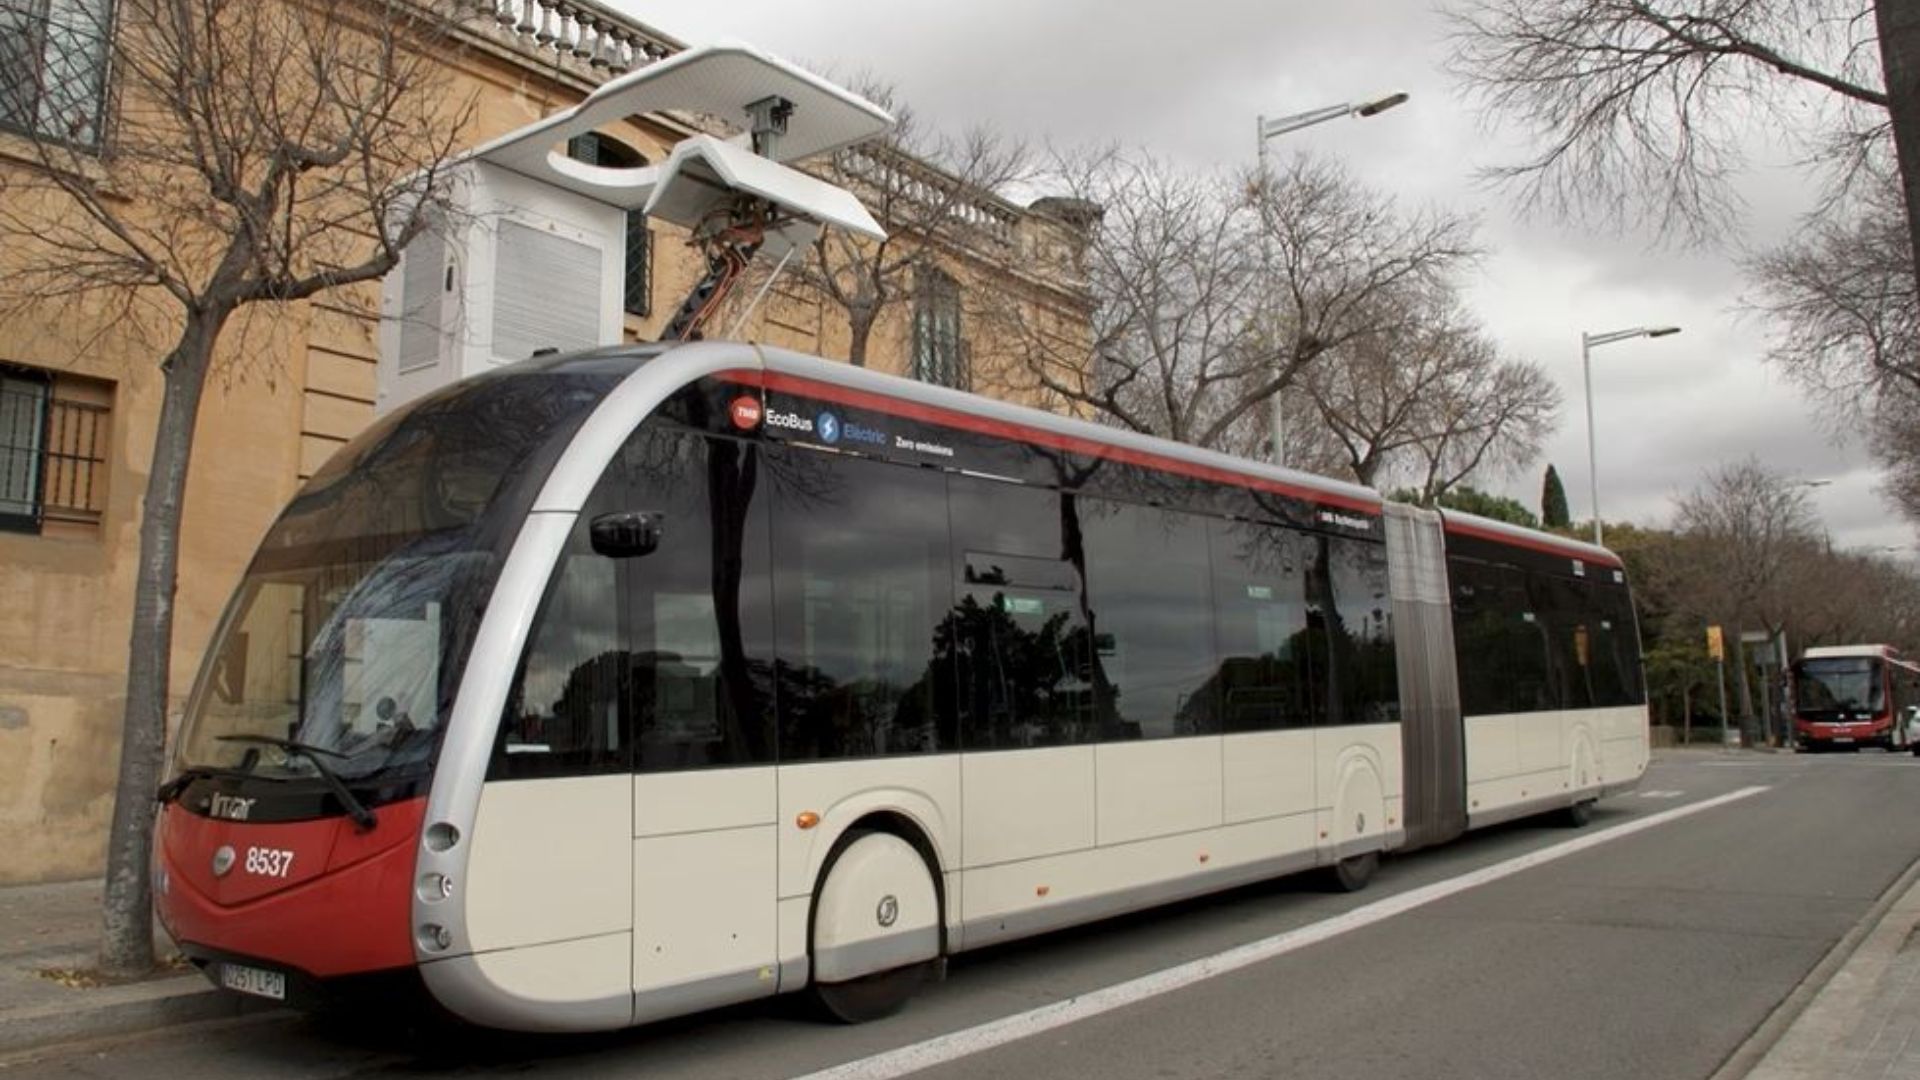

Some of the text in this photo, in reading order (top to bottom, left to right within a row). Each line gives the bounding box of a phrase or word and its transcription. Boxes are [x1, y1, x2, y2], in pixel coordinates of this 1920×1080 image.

[766, 408, 813, 431] EcoBus
[895, 435, 914, 450] Zero
[246, 846, 294, 878] 8537
